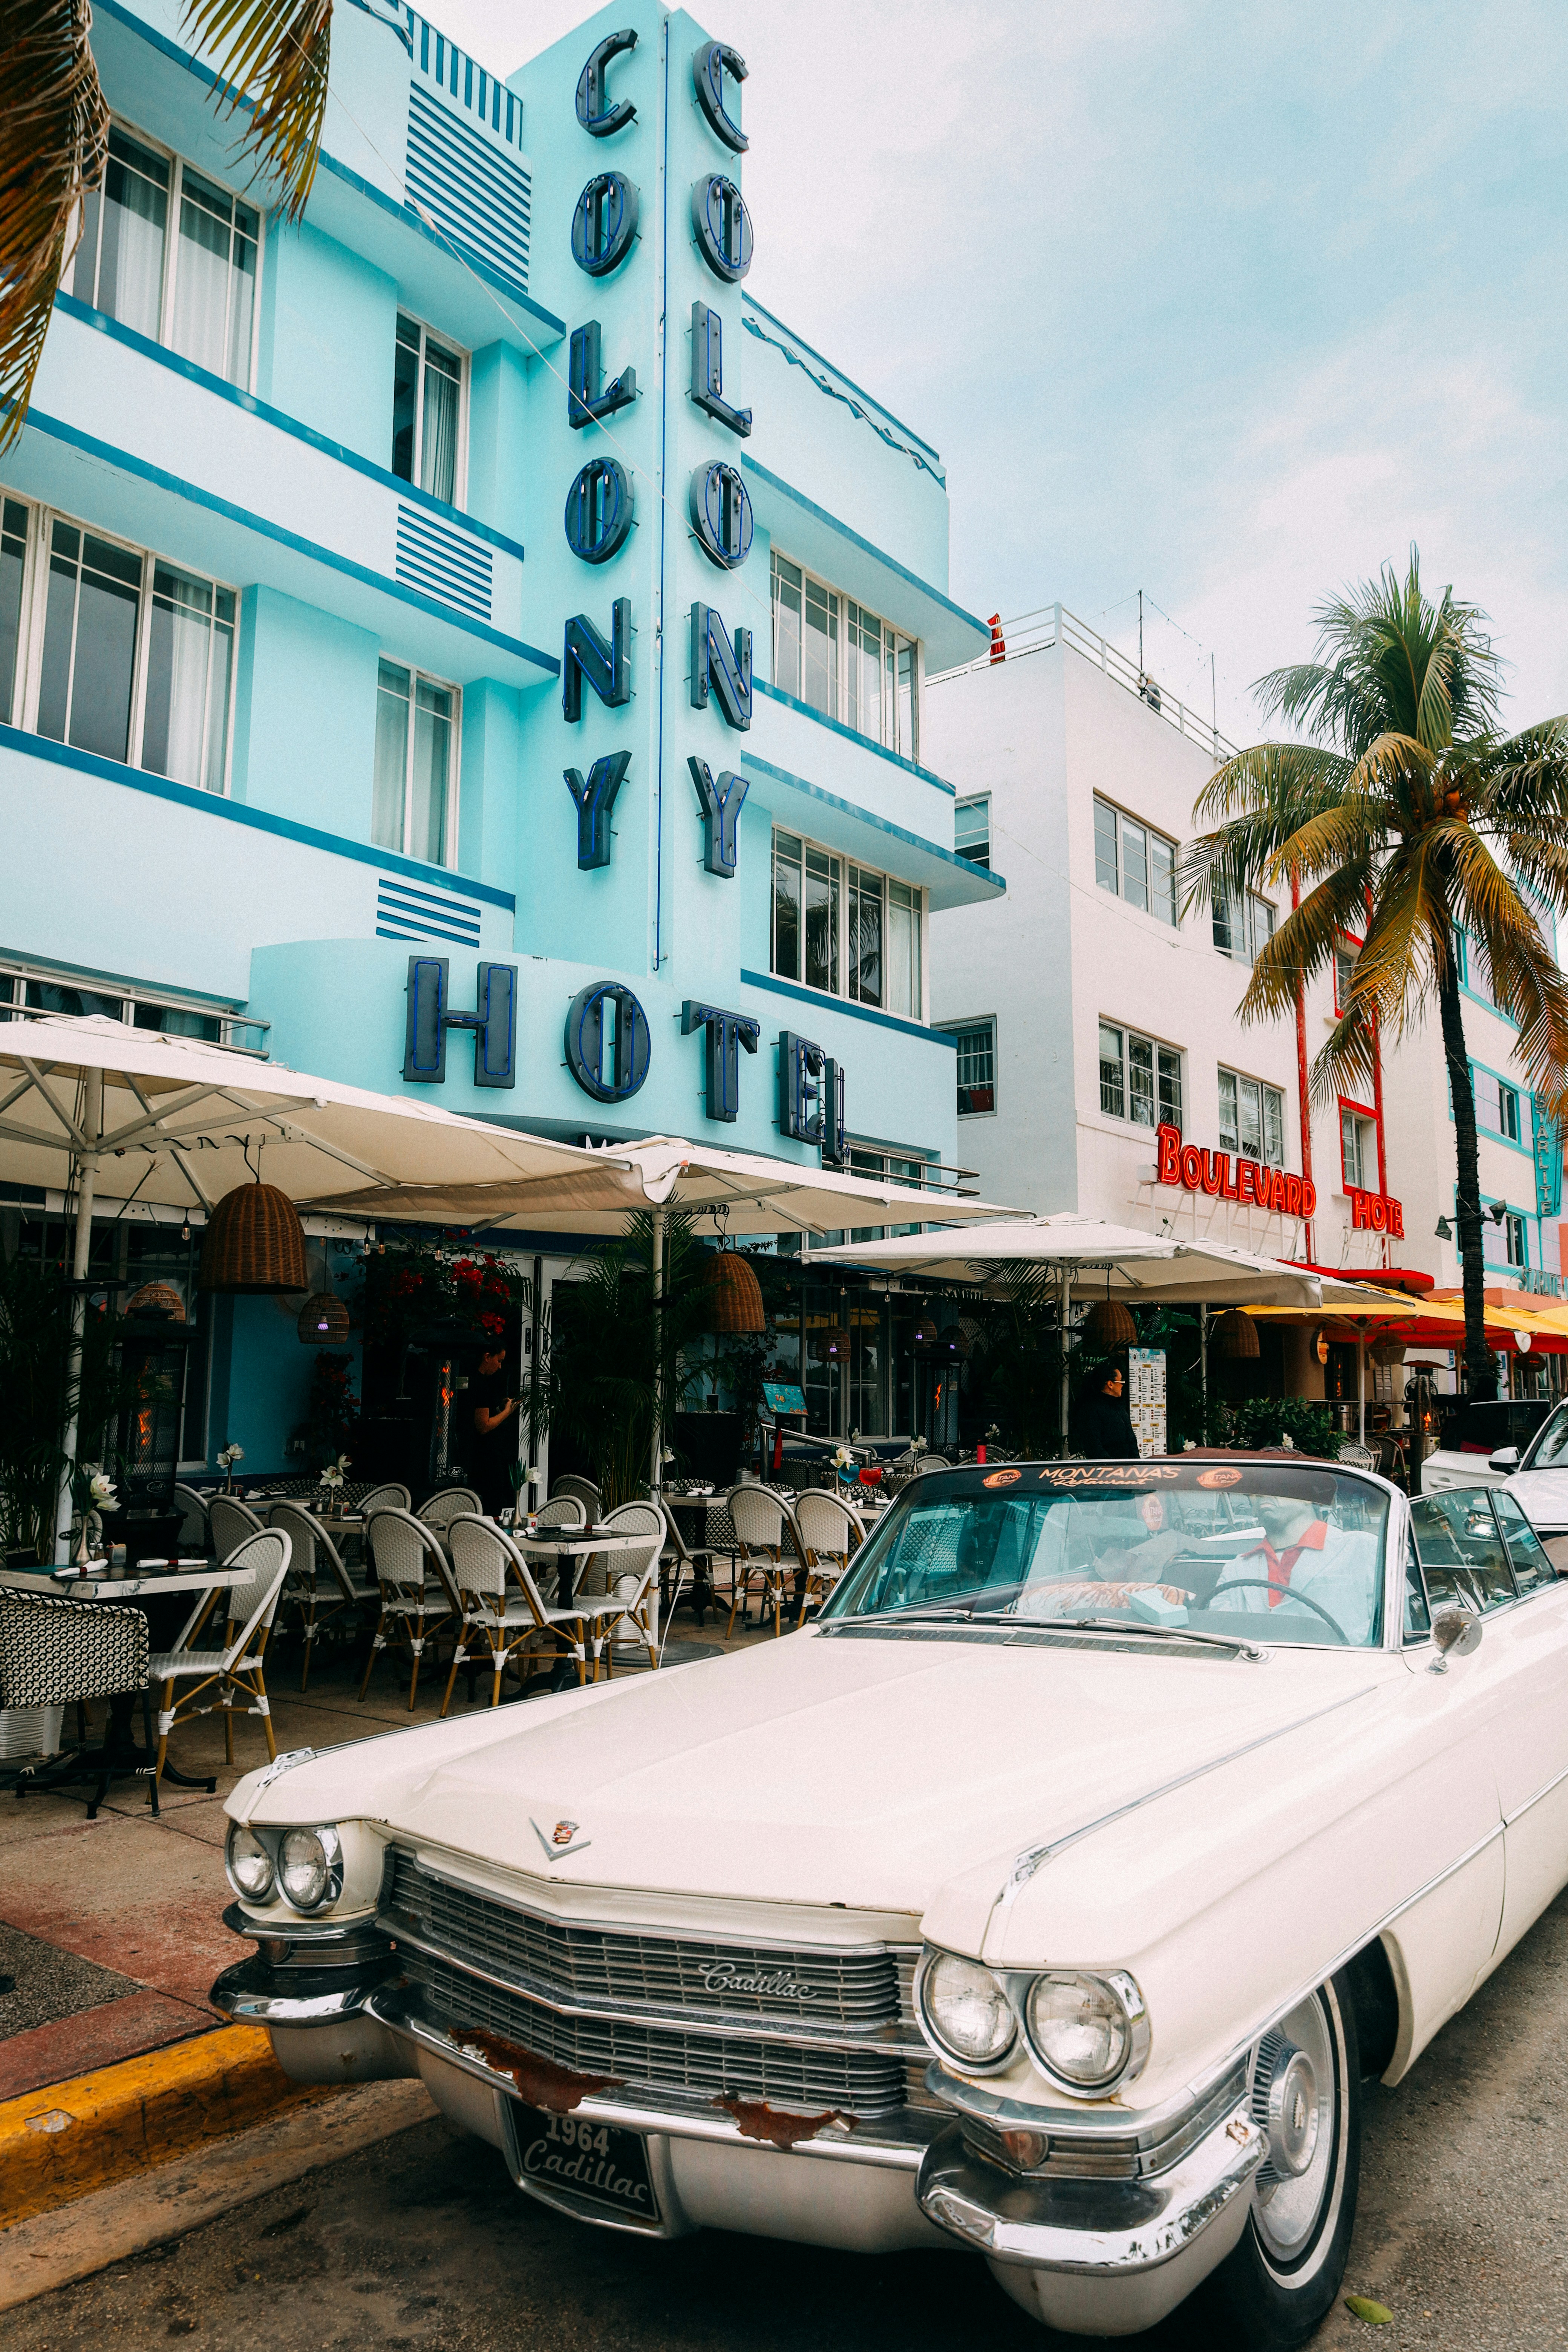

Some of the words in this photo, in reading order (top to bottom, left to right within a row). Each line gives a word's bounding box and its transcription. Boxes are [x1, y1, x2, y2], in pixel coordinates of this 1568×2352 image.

[563, 28, 639, 871] COLONY
[687, 40, 754, 878] COLONY
[403, 955, 850, 1165] HOTEL
[1156, 1122, 1317, 1218] BOULEVARD
[1352, 1189, 1405, 1240] HOTEL
[1534, 1092, 1553, 1215] STARLITE
[1038, 1467, 1182, 1479] MONTANA'S
[1049, 1478, 1154, 1487] Restaurant
[698, 1963, 818, 2000] Cadillac
[524, 2139, 648, 2202] Cadillac
[546, 2115, 609, 2157] 1964
